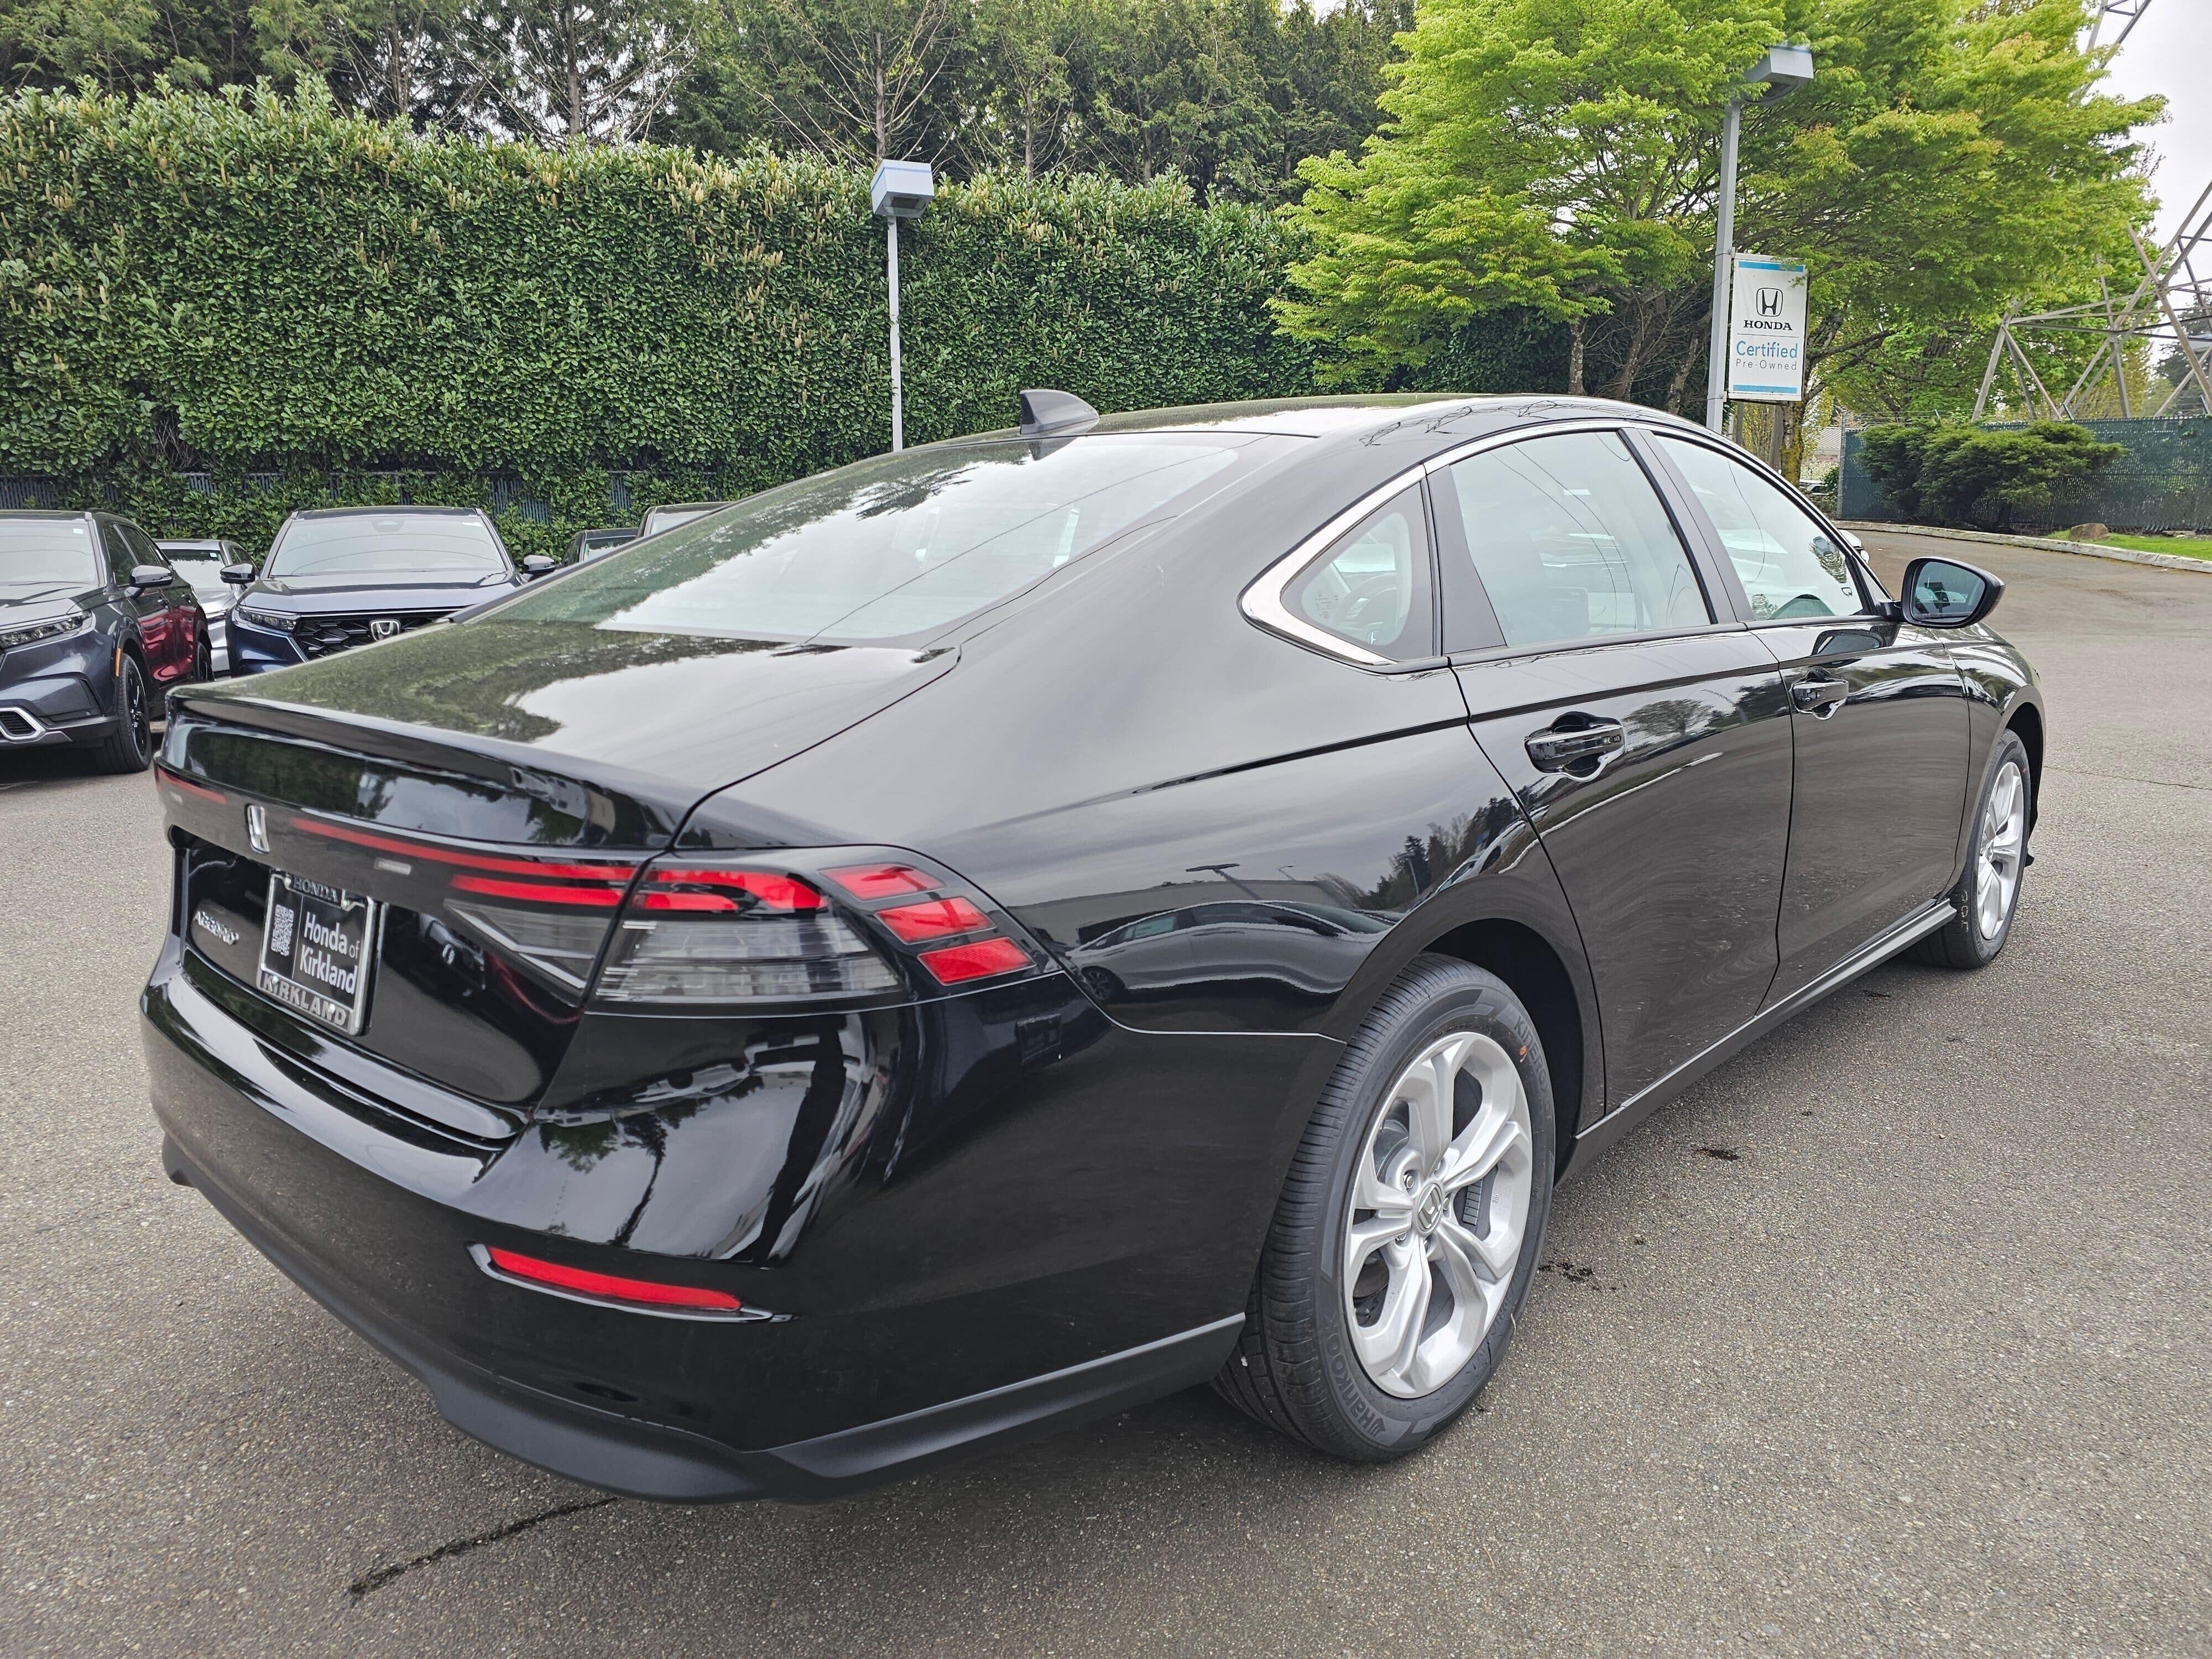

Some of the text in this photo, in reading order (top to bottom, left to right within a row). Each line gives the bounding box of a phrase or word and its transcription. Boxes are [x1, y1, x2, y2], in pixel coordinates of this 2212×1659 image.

[1743, 320, 1793, 331] HONDA
[1736, 340, 1798, 358] Certified
[1736, 358, 1797, 371] Pre-Owned
[304, 912, 360, 959] Honda of
[299, 945, 358, 994] Kirkland
[263, 975, 346, 1026] KIRKLAND
